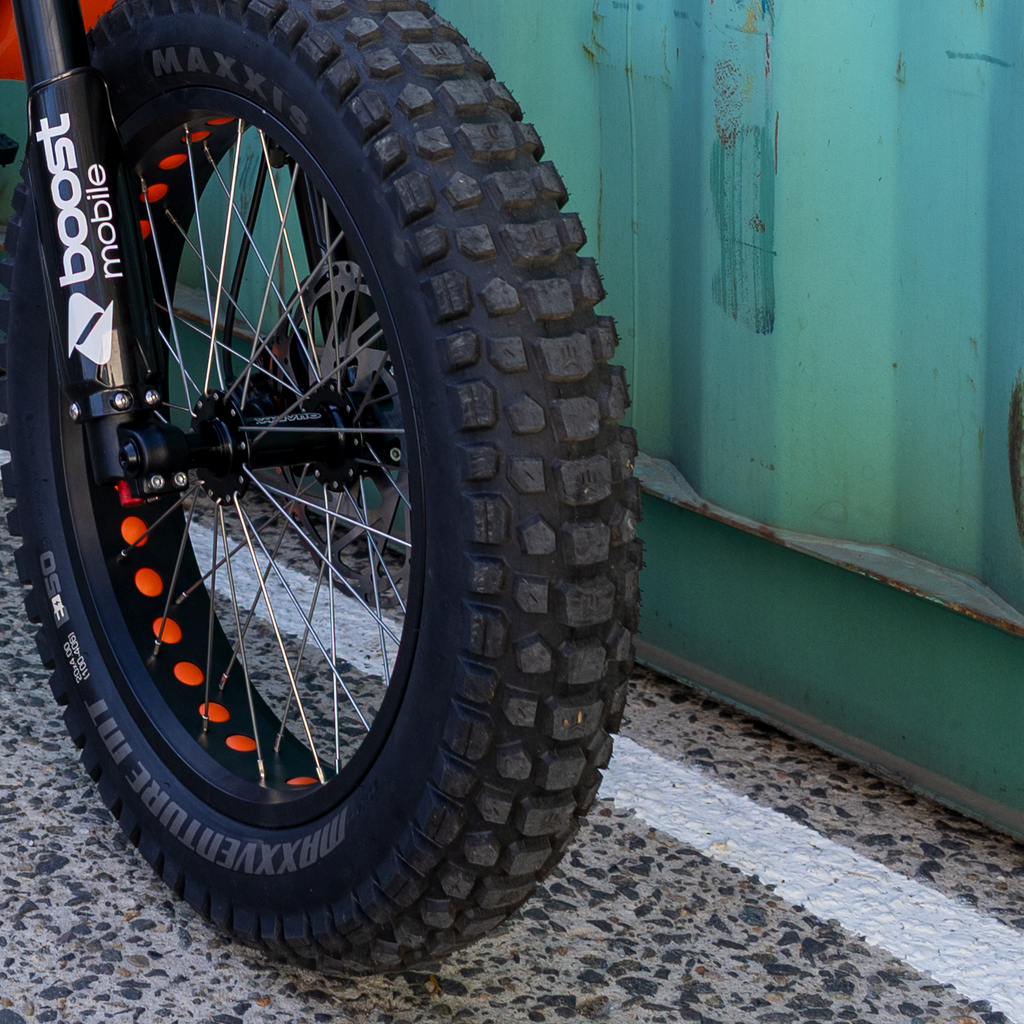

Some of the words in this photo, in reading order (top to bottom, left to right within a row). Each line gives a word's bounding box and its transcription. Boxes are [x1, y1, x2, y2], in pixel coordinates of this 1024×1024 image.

[152, 46, 309, 135] MAXXIS
[35, 112, 96, 288] boost
[85, 163, 124, 279] mobile
[84, 698, 133, 765] MT
[125, 760, 349, 875] MAXXVENTURE
